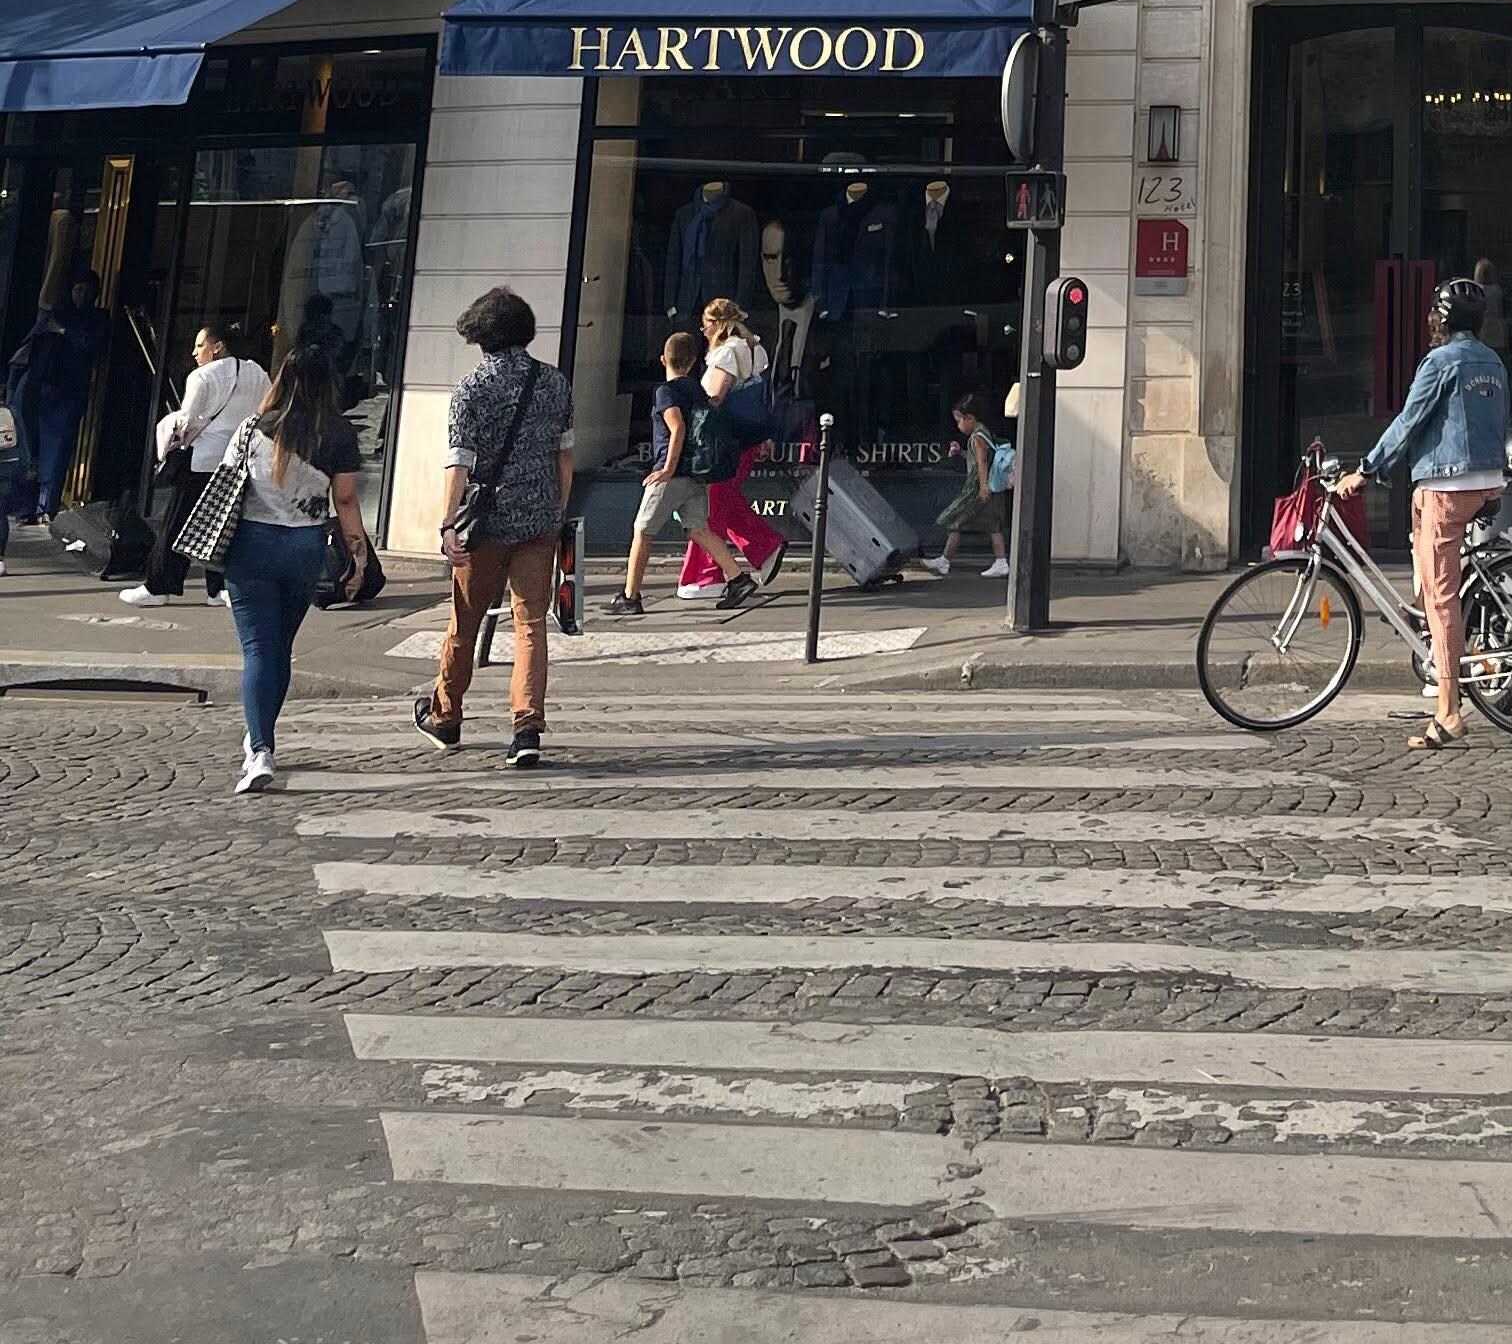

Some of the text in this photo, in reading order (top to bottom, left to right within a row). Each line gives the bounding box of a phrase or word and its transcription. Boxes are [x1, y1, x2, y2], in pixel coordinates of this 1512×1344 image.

[566, 27, 925, 71] HARTWOOD
[1138, 176, 1183, 204] 123
[1162, 231, 1179, 252] H
[856, 443, 941, 463] SHIRTS
